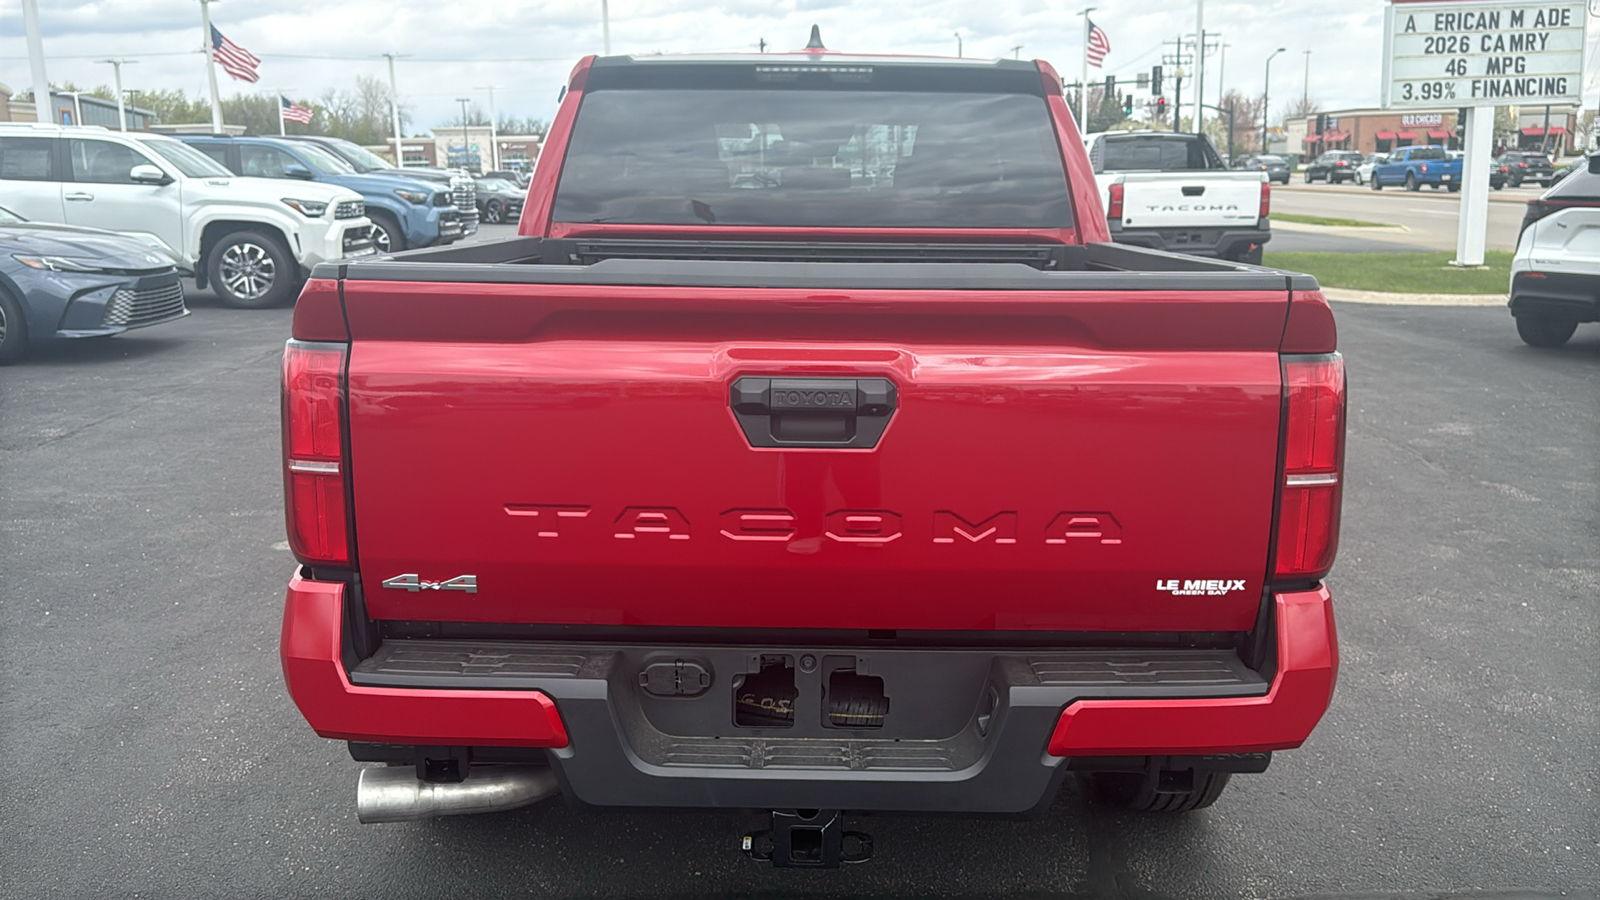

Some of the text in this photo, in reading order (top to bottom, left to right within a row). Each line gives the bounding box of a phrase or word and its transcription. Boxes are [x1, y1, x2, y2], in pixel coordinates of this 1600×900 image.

[1424, 32, 1550, 55] 2026 CAMRY
[1445, 56, 1526, 76] 46 MPG
[1402, 77, 1567, 100] 3.99% FINANCING
[1146, 204, 1239, 212] TACOMA
[774, 390, 852, 406] TOYOTA
[504, 502, 1124, 545] TACOMA
[1156, 579, 1246, 590] LE MIEUX
